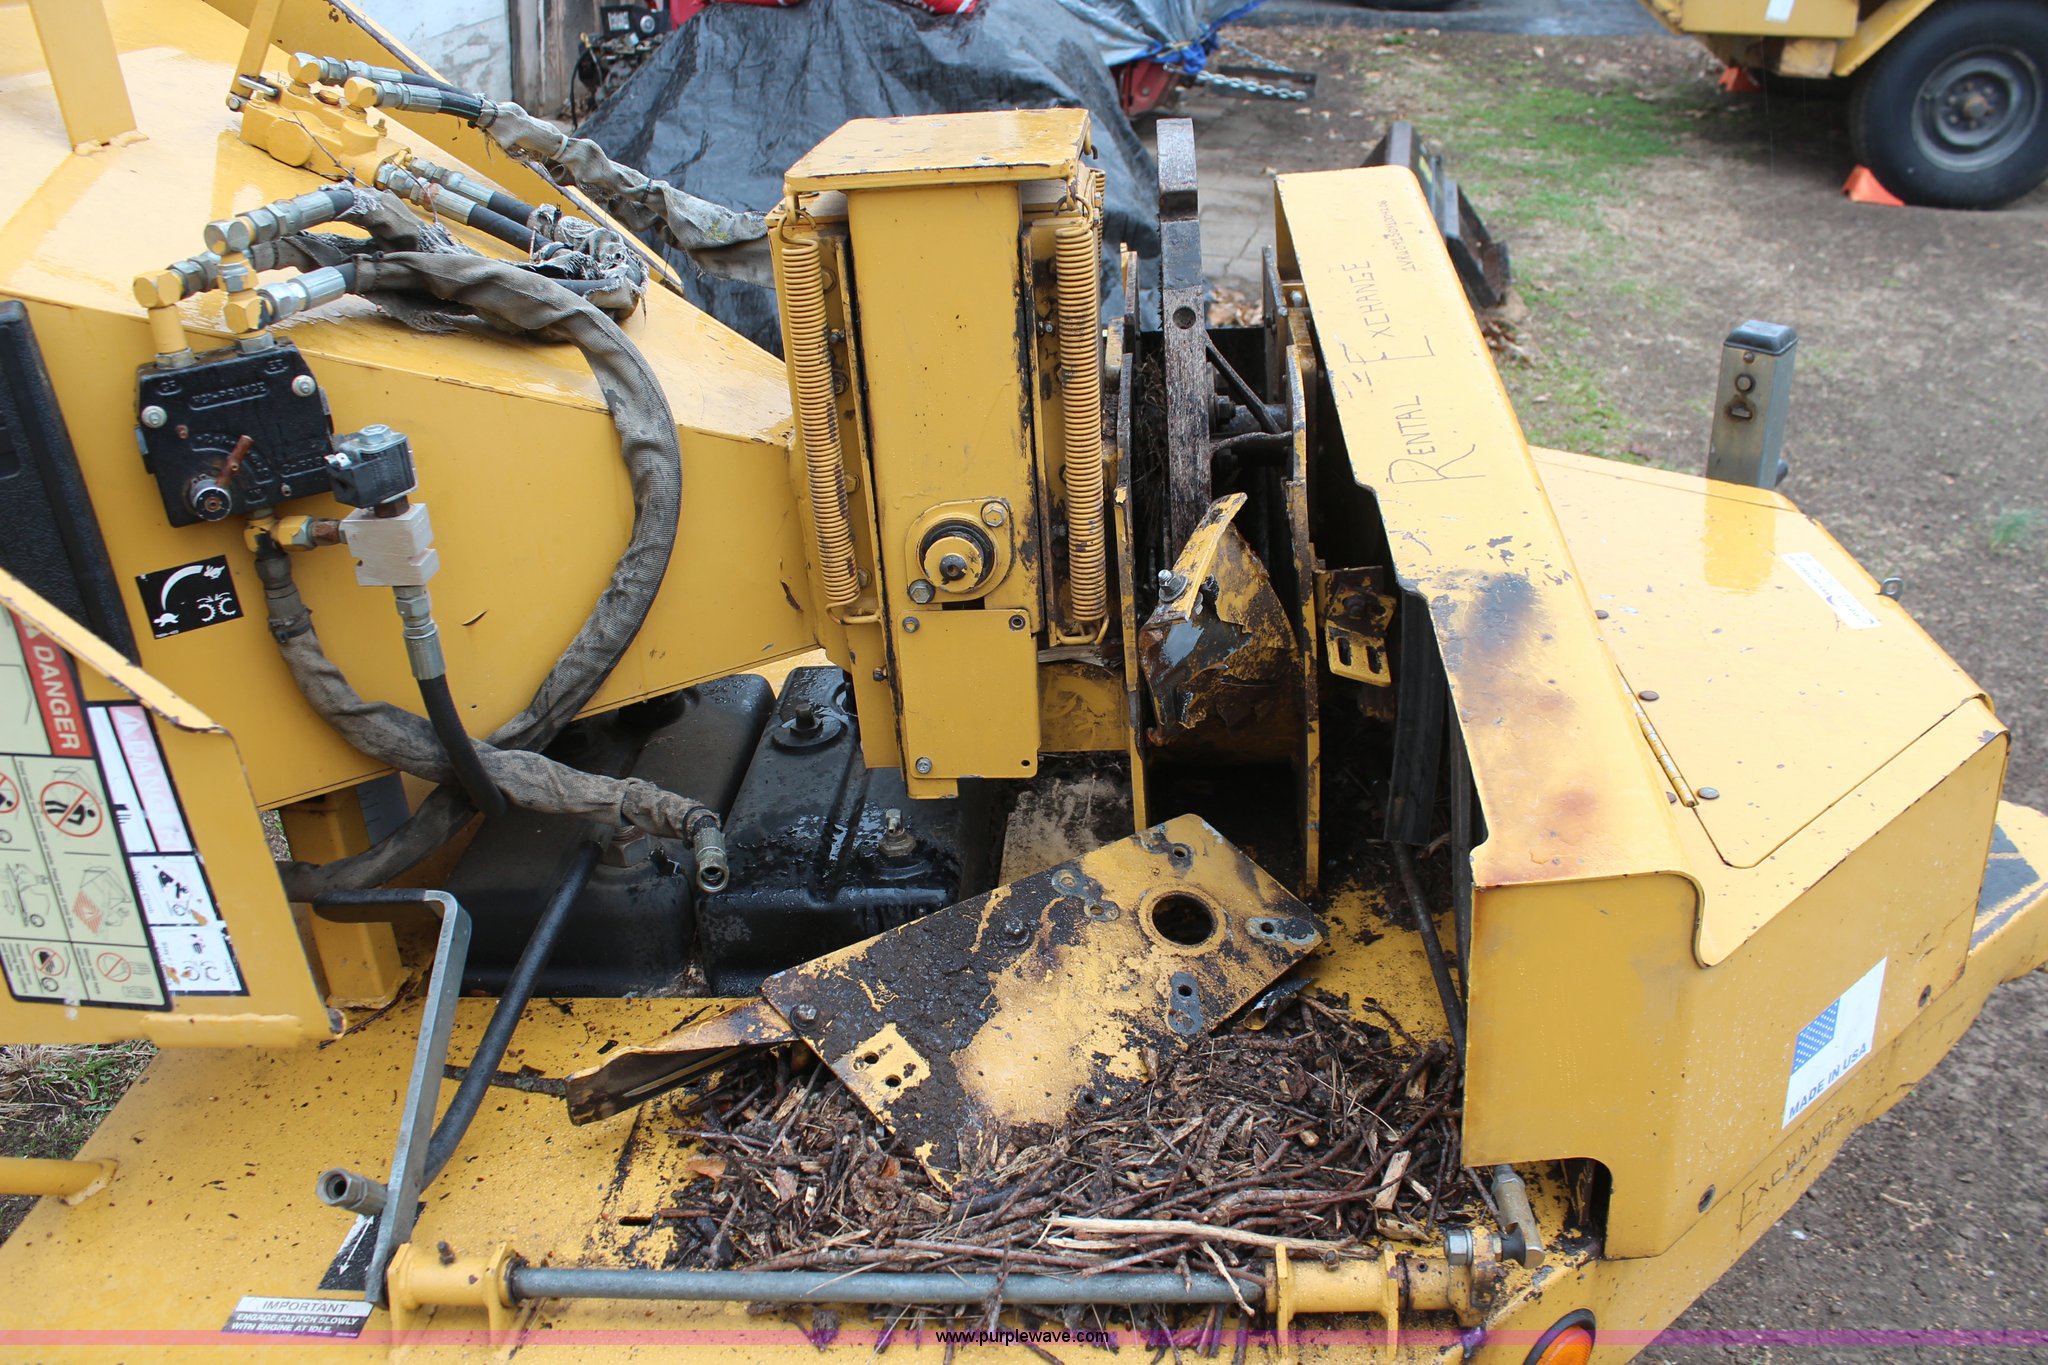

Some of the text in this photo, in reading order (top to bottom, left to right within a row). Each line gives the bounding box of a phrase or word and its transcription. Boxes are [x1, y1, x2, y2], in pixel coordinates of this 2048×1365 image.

[1341, 260, 1486, 484] RENTAL EXCHANGE
[33, 645, 80, 749] DANGER
[1789, 1042, 1866, 1119] MADE IN USA
[231, 1322, 333, 1334] WITH ENGINE AT IDLE.
[236, 1313, 359, 1326] ENGAGE CLUTCH SLOWLY
[262, 1301, 347, 1313] IMPORTANT
